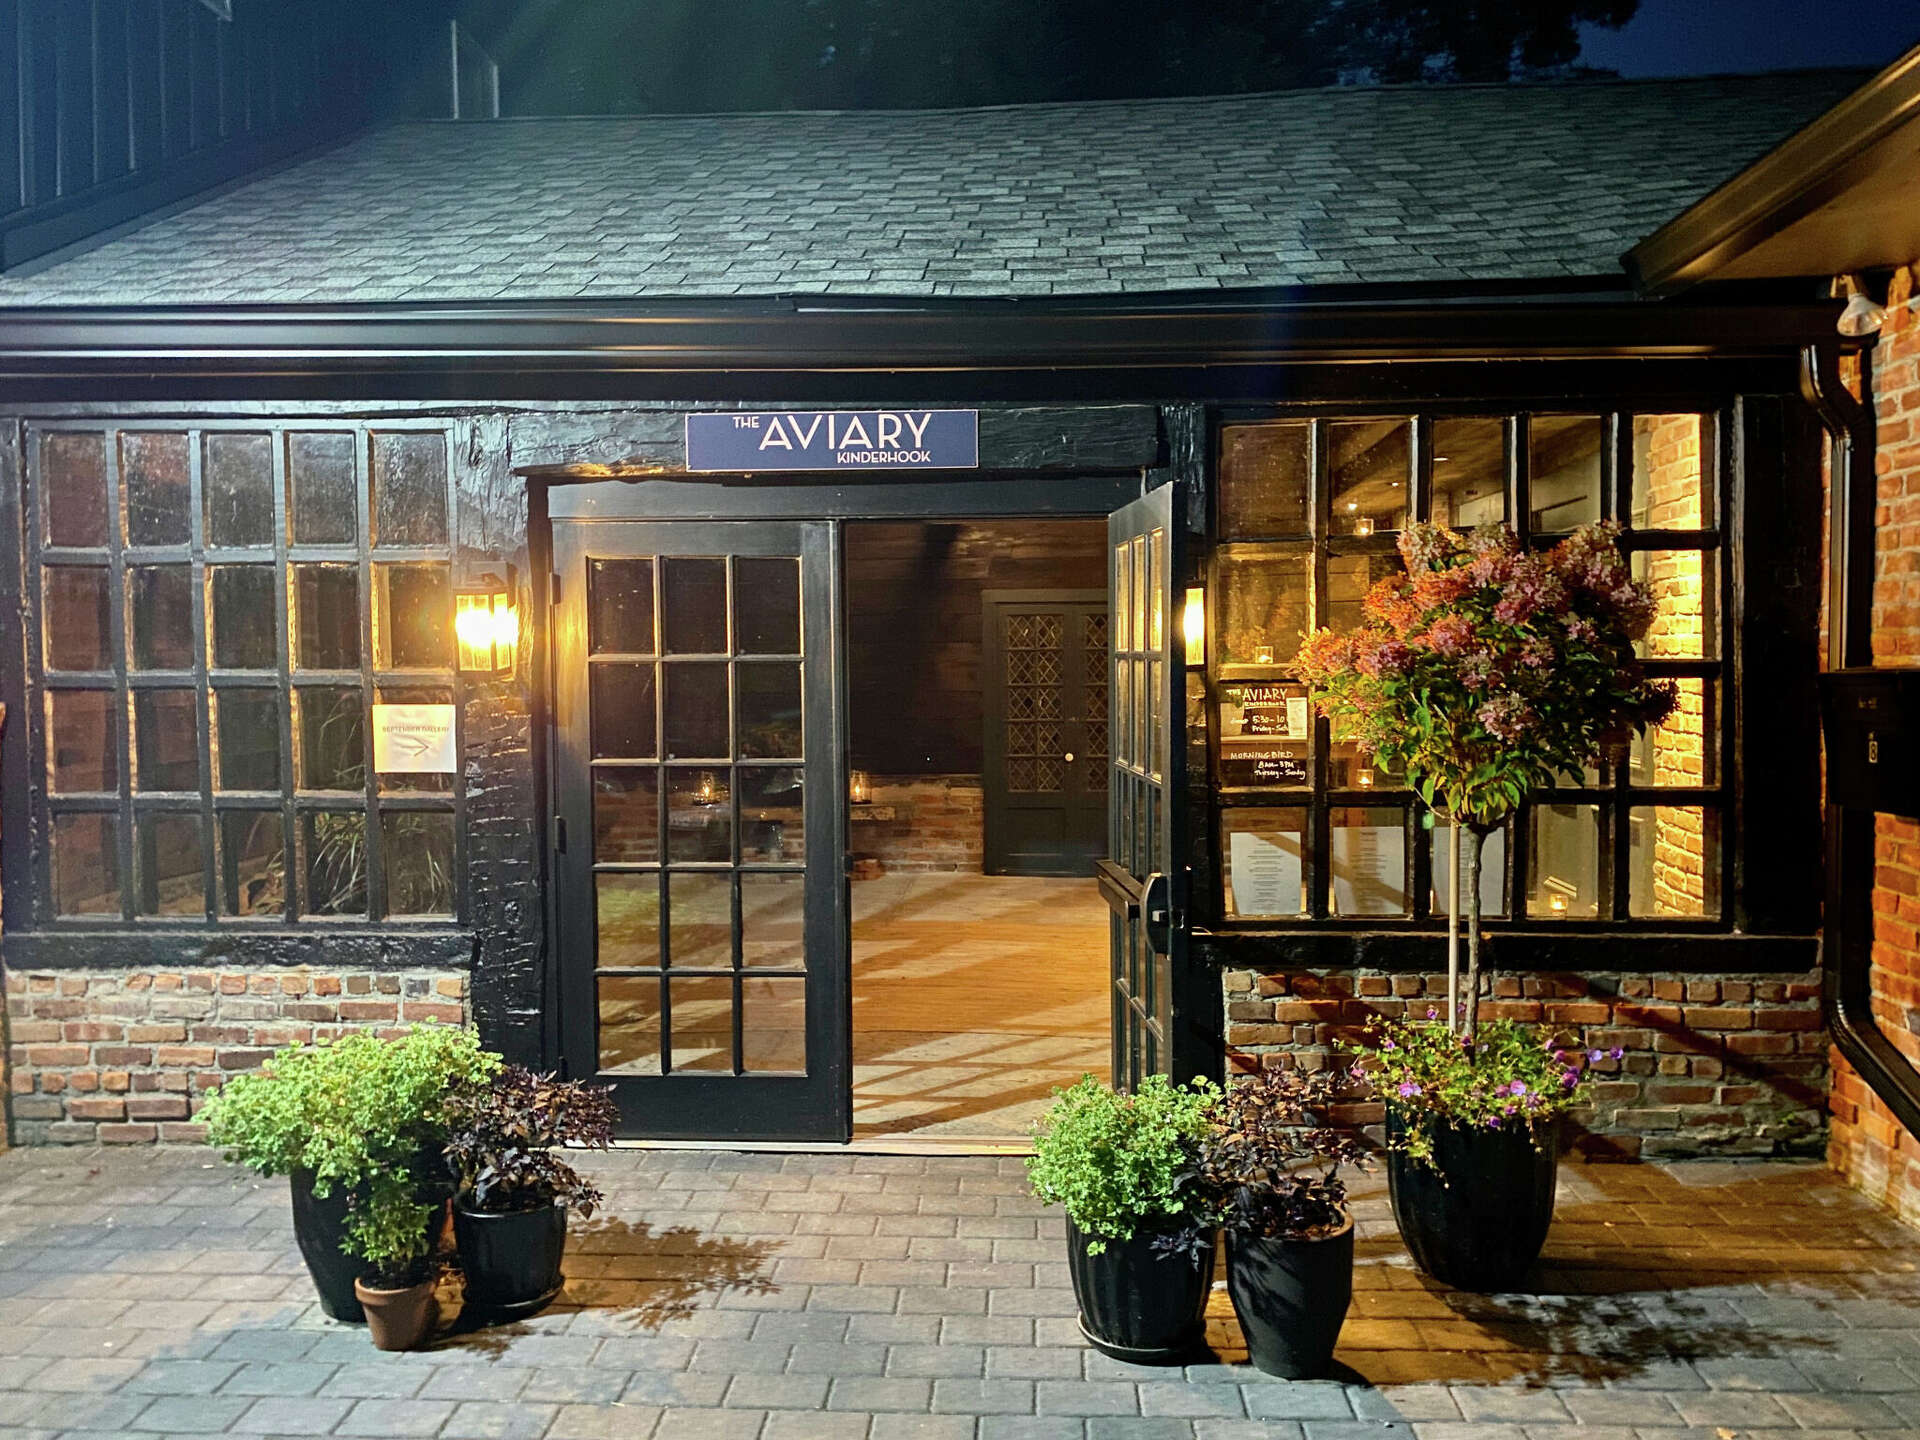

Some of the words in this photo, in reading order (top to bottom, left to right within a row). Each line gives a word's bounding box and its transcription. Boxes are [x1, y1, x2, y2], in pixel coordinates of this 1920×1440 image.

[733, 416, 759, 429] THE
[759, 413, 932, 450] AVIARY
[837, 451, 931, 464] KINDERHOOK
[1242, 687, 1288, 701] AVIARY
